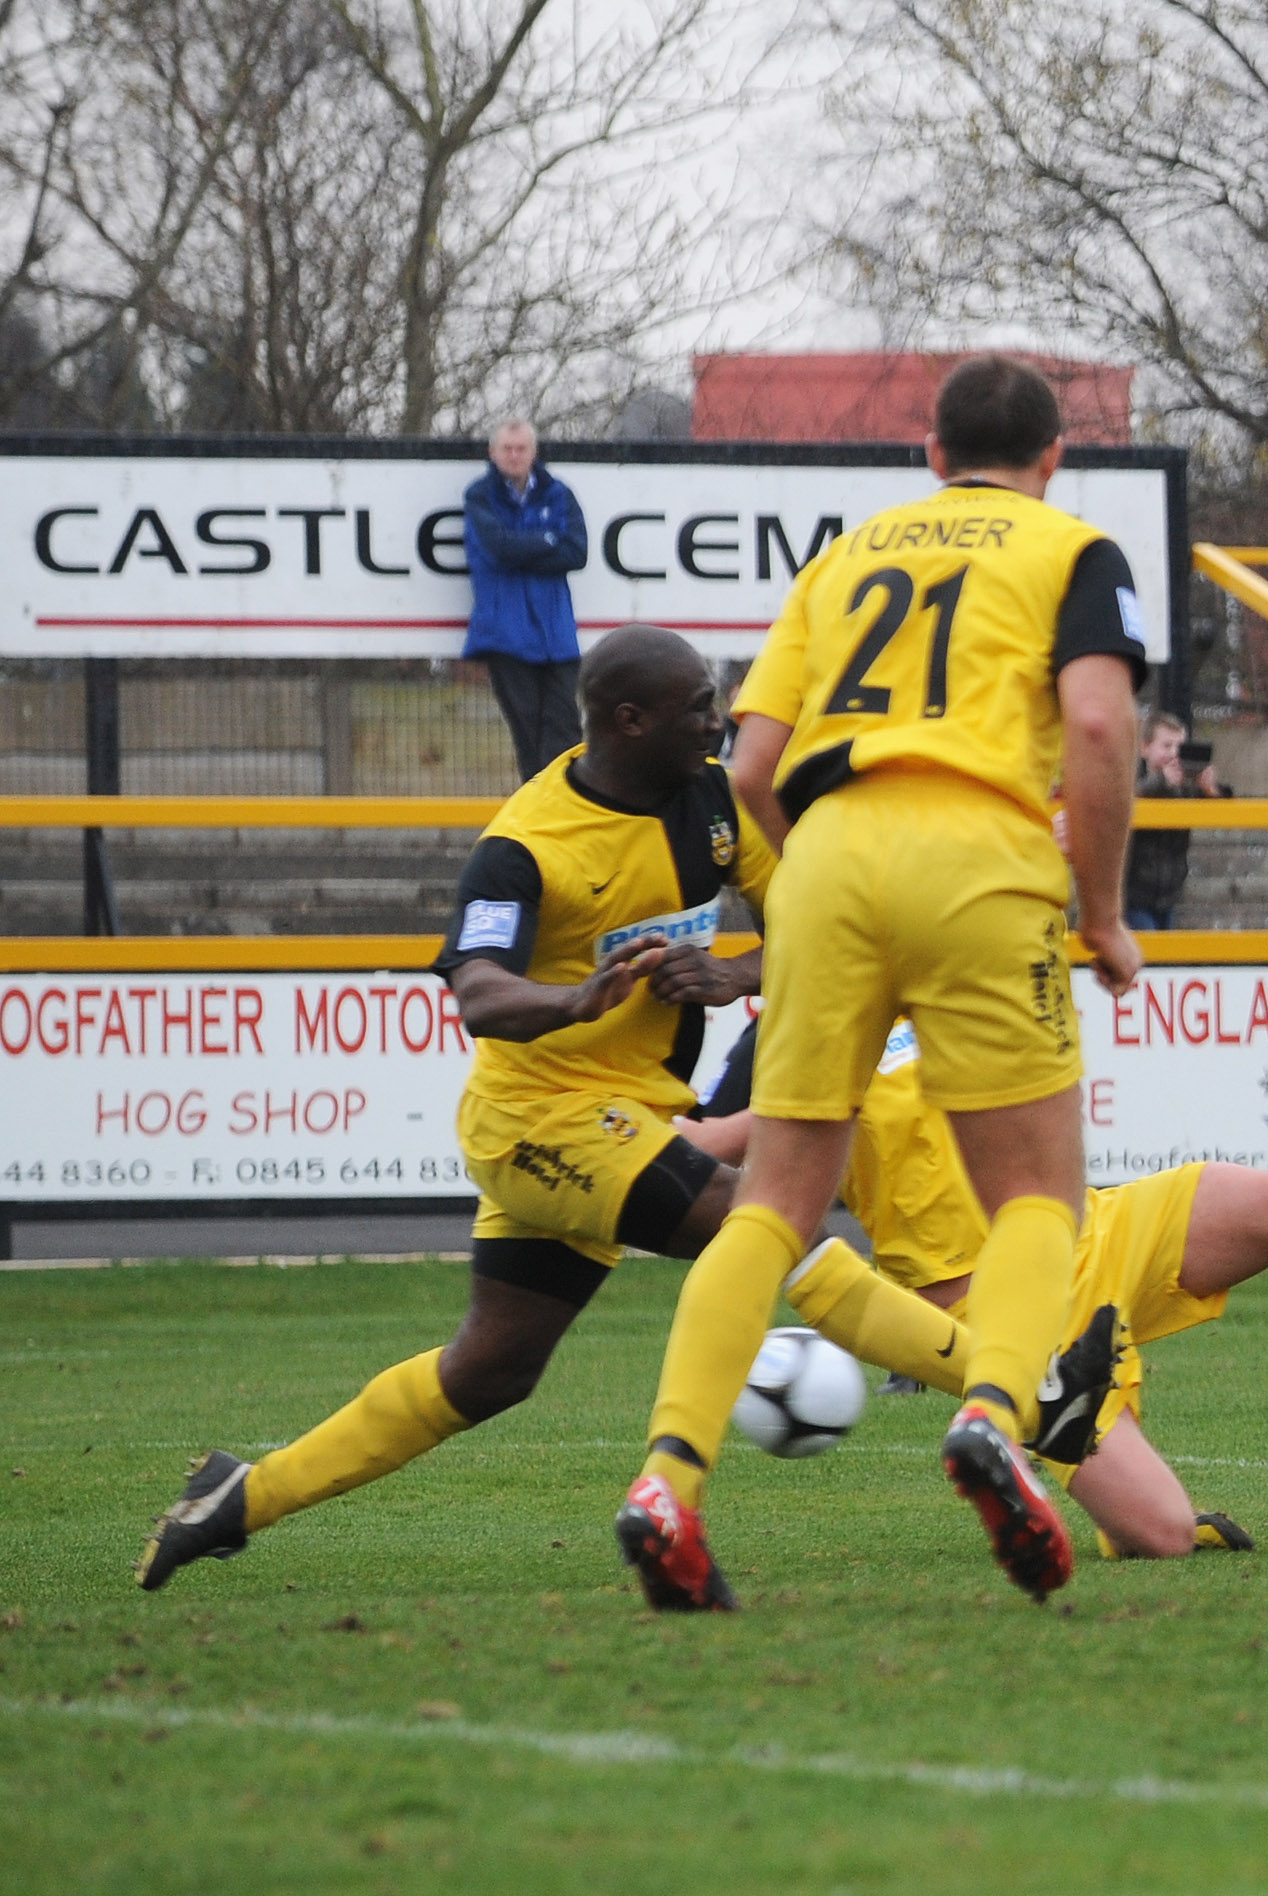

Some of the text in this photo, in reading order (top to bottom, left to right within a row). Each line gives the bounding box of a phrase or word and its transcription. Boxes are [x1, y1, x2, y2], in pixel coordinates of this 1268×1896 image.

[34, 507, 470, 576] CASTLE
[846, 517, 1013, 555] TURNER
[823, 566, 970, 719] 21
[0, 987, 263, 1055] OGFATHER
[96, 1091, 207, 1136] HOG
[229, 1089, 366, 1134] SHOP
[61, 1160, 151, 1186] 8360
[236, 1158, 325, 1184] 0845
[340, 1158, 403, 1184] 644
